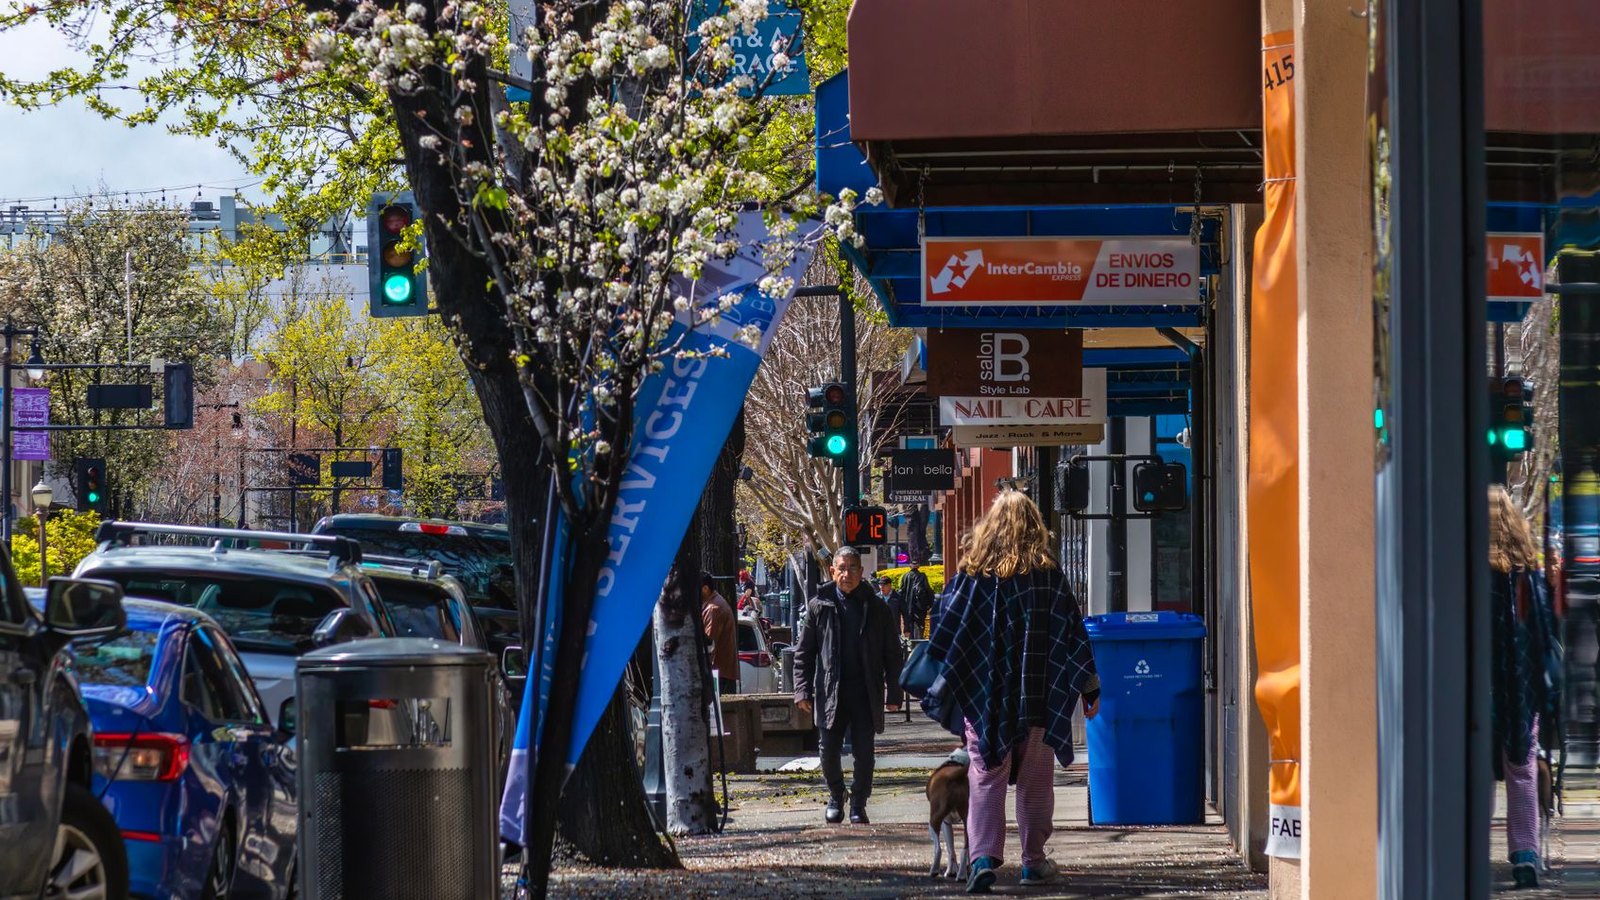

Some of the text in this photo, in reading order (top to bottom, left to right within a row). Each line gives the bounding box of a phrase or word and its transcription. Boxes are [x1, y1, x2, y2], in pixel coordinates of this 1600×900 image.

[1265, 54, 1295, 90] 415
[987, 262, 1082, 275] InterCambio
[1109, 254, 1174, 268] ENVIOS
[1096, 273, 1192, 287] DE DINERO
[976, 333, 993, 380] salon
[980, 385, 1031, 396] Style Lab
[954, 399, 1092, 418] NAIL CARE
[598, 354, 708, 597] SERVICES
[894, 464, 954, 475] tan bella
[870, 514, 884, 539] 12
